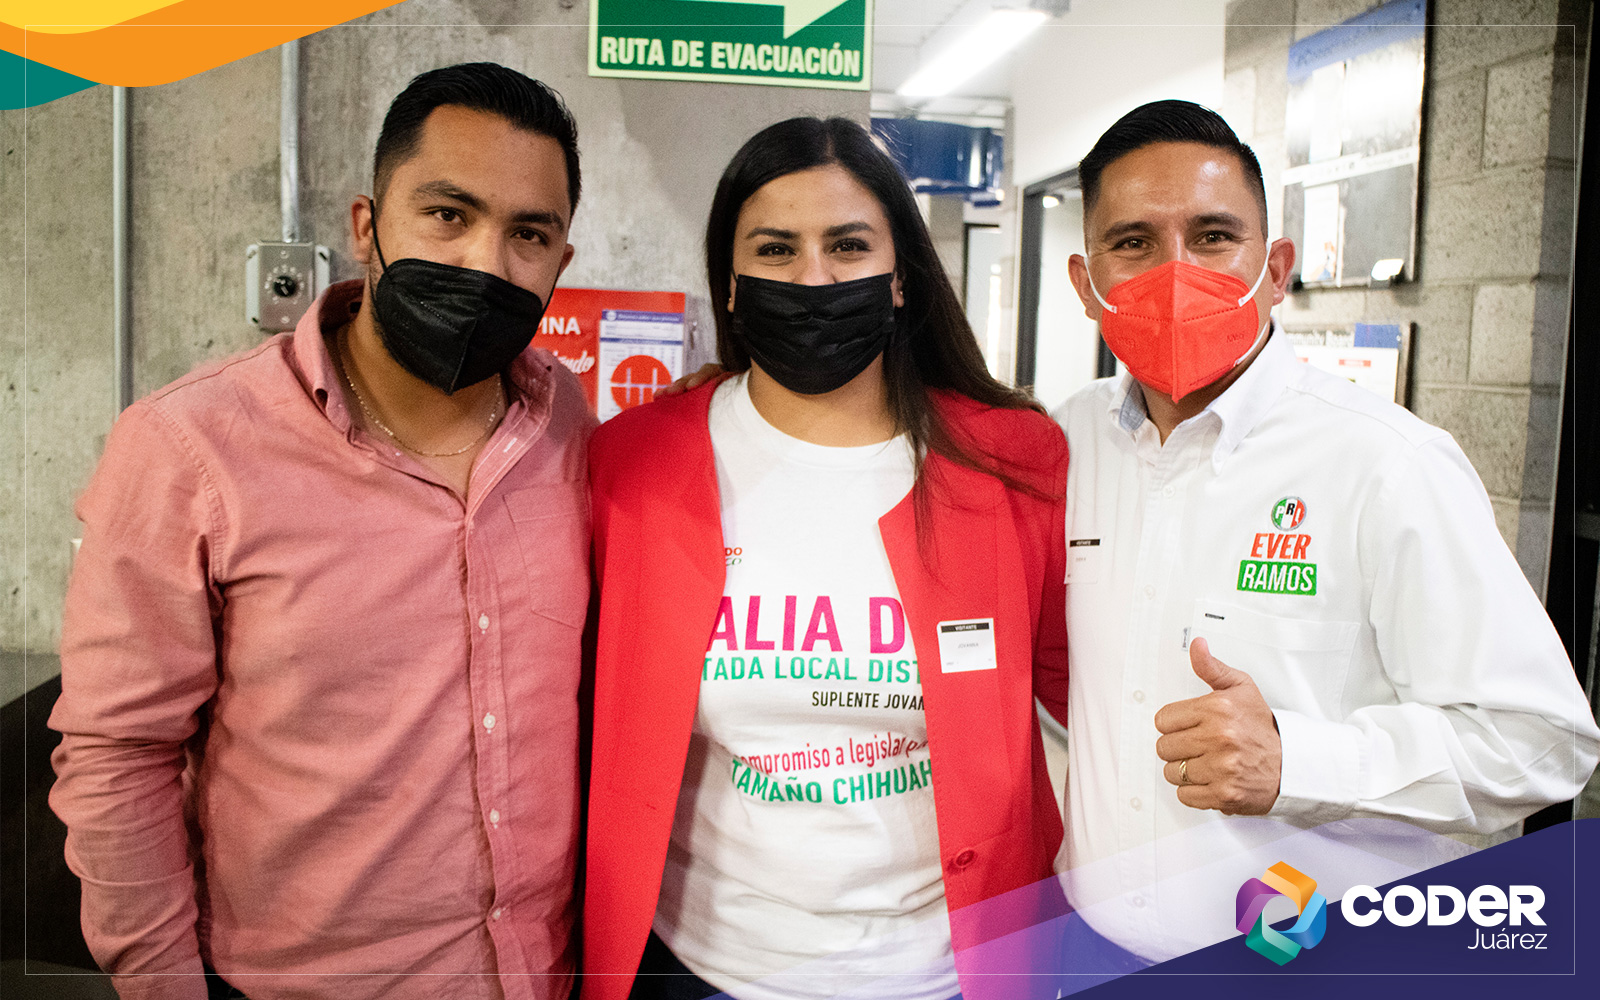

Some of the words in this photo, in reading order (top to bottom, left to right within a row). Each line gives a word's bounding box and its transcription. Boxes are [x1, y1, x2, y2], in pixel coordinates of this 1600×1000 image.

[601, 36, 665, 66] RUTA
[672, 39, 704, 68] DE
[711, 41, 860, 77] EVACUACIÓN
[1275, 503, 1302, 524] PRI
[1250, 533, 1312, 560] EVER
[1241, 563, 1314, 592] RAMOS
[706, 595, 843, 652] ALIA
[869, 596, 905, 654] D
[703, 656, 764, 681] TADA
[775, 656, 857, 681] LOCAL
[812, 691, 879, 708] SUPLENTE
[836, 746, 845, 766] a
[732, 759, 822, 803] TAMAÑO
[833, 759, 933, 805] CHIHUAH
